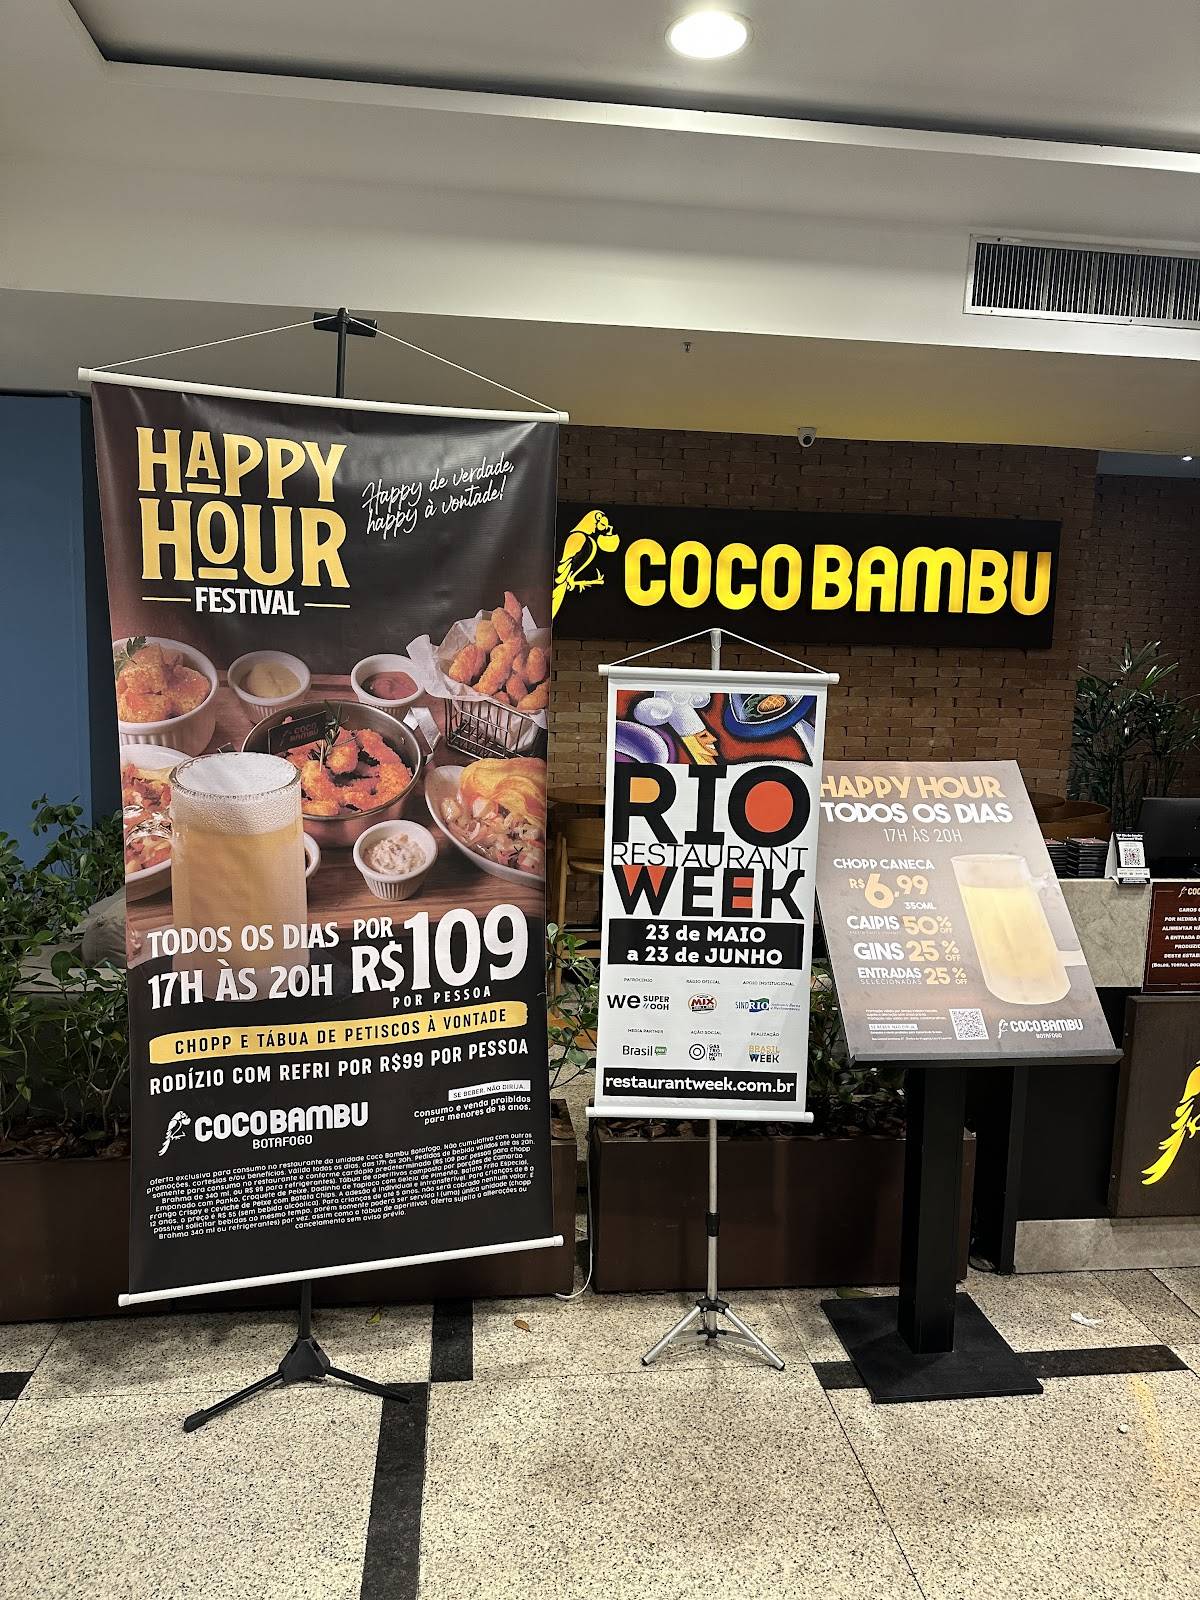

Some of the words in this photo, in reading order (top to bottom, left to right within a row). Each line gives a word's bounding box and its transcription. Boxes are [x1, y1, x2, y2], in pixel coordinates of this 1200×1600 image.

[136, 426, 348, 503] HAPPY
[362, 478, 423, 515] Happy
[429, 468, 448, 492] de
[453, 451, 515, 486] verdade,
[366, 507, 418, 540] happy
[424, 499, 437, 518] à
[442, 475, 507, 514] vontade!
[139, 498, 351, 588] HOUR
[195, 587, 301, 616] FESTIVAL
[820, 775, 911, 799] HAPPY
[919, 776, 1007, 799] HOUR
[612, 763, 811, 848] RIO
[820, 802, 909, 824] TODOS
[912, 803, 952, 824] OS
[954, 803, 1013, 824] DIAS
[883, 828, 908, 842] 17H
[911, 825, 930, 842] ÀS
[933, 828, 963, 843] 20H
[612, 842, 809, 871] RESTAURANT
[833, 858, 878, 869] CHOPP
[880, 859, 935, 870] CANECA
[611, 864, 806, 920] WEEK
[904, 901, 937, 910] 350ML
[353, 916, 394, 941] POR
[645, 924, 670, 941] 23
[675, 925, 701, 941] de
[706, 926, 767, 943] MAIO
[846, 915, 900, 930] CAIPIS
[146, 925, 232, 959] TODOS
[240, 923, 275, 952] OS
[283, 921, 340, 951] DIAS
[853, 942, 905, 961] GINS
[626, 949, 639, 962] a
[644, 946, 669, 962] 23
[674, 946, 700, 963] de
[704, 947, 783, 966] JUNHO
[147, 968, 204, 1010] 17H
[214, 959, 258, 1002] ÀS
[268, 963, 334, 999] 20H
[857, 967, 922, 979] ENTRADAS
[392, 993, 424, 1009] POR
[433, 985, 492, 1006] PESSOA
[643, 995, 670, 1003] SUPER
[690, 998, 715, 1007] MIX
[174, 1036, 232, 1055] CHOPP
[240, 1034, 249, 1049] E
[256, 1028, 309, 1049] TÁBUA
[317, 1028, 336, 1044] DE
[345, 1020, 420, 1042] PETISCOS
[427, 1010, 437, 1031] À
[443, 1008, 507, 1031] VONTADE
[622, 1045, 653, 1056] Brasil
[749, 1054, 780, 1063] WEEK
[149, 1068, 225, 1096] RODÍZIO
[232, 1065, 271, 1084] COM
[279, 1061, 331, 1081] REFRI
[338, 1056, 373, 1076] POR
[379, 1051, 425, 1073] R$99
[430, 1047, 464, 1067] POR
[468, 1038, 529, 1060] PESSOA
[605, 1075, 795, 1093] restaurantweek.com.br
[413, 1105, 454, 1118] Consumo
[463, 1098, 489, 1110] venda
[490, 1095, 531, 1105] proibidos
[424, 1115, 445, 1125] para
[447, 1109, 484, 1121] menores
[486, 1105, 496, 1114] de
[508, 1103, 531, 1111] anos.
[252, 1134, 313, 1149] BOTAFOGO
[175, 1172, 211, 1181] exclusiva
[212, 1169, 231, 1178] para
[232, 1165, 266, 1174] consumo
[279, 1159, 323, 1168] restaurante
[385, 1150, 409, 1158] Bambu
